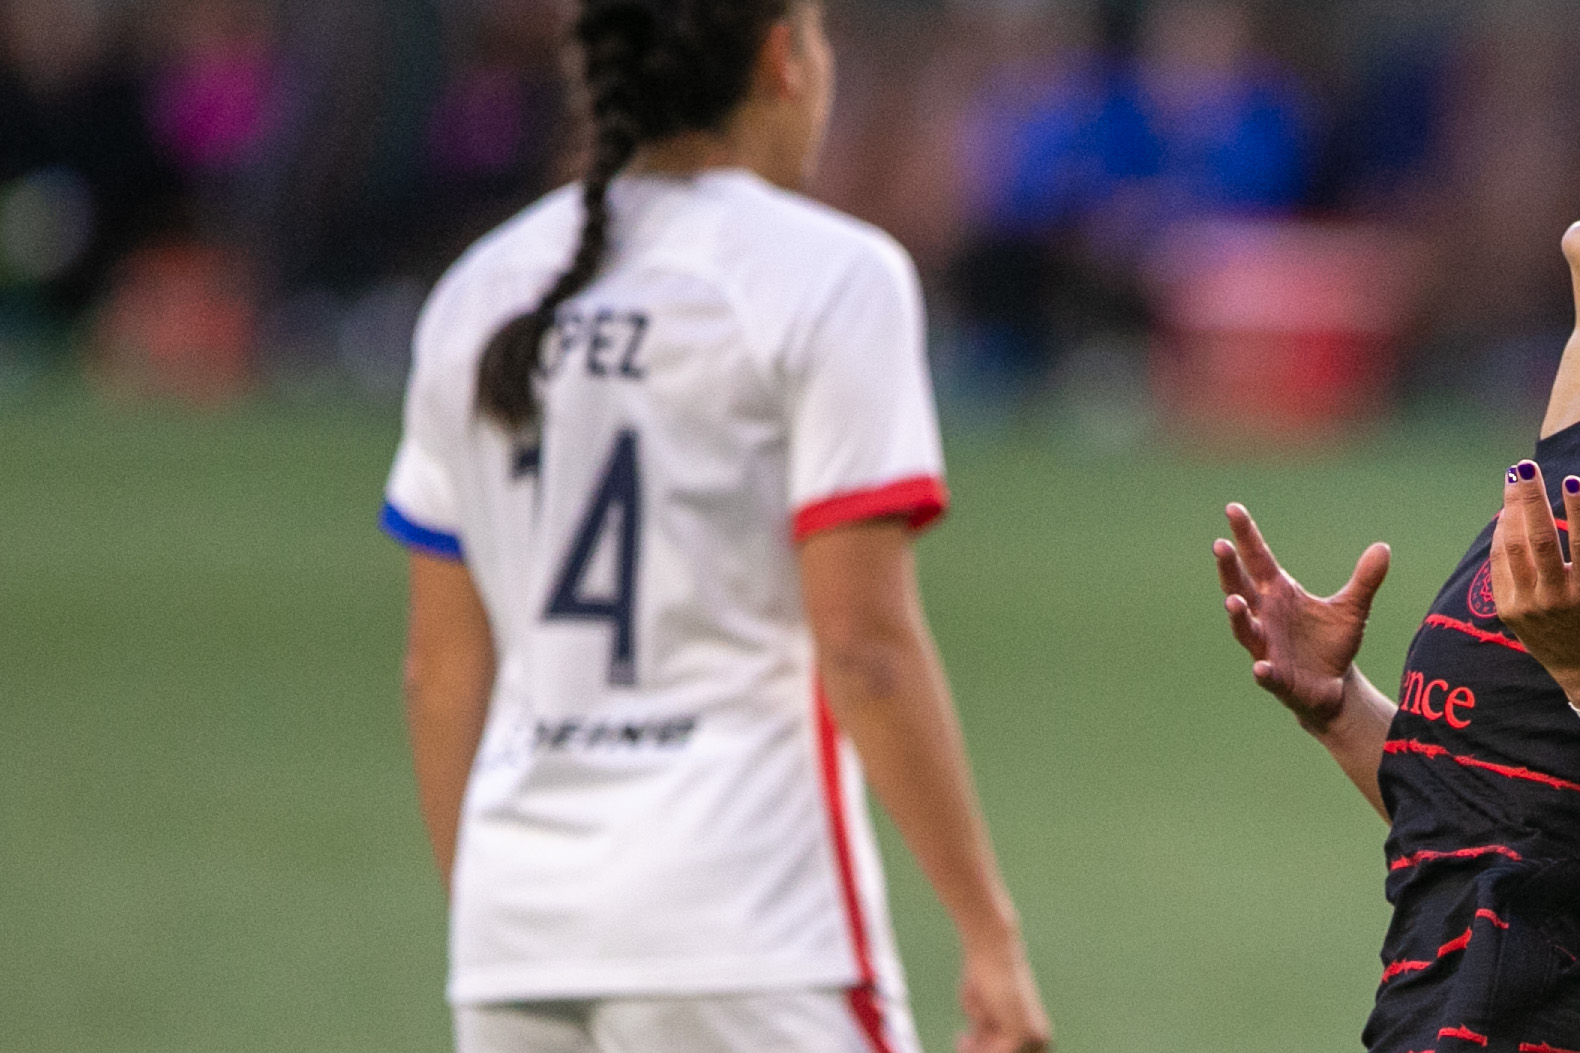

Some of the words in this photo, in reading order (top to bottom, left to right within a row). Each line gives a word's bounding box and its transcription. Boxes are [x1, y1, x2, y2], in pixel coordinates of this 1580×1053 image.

[536, 311, 650, 378] PEZ
[509, 425, 640, 686] 4
[1400, 669, 1475, 730] nce
